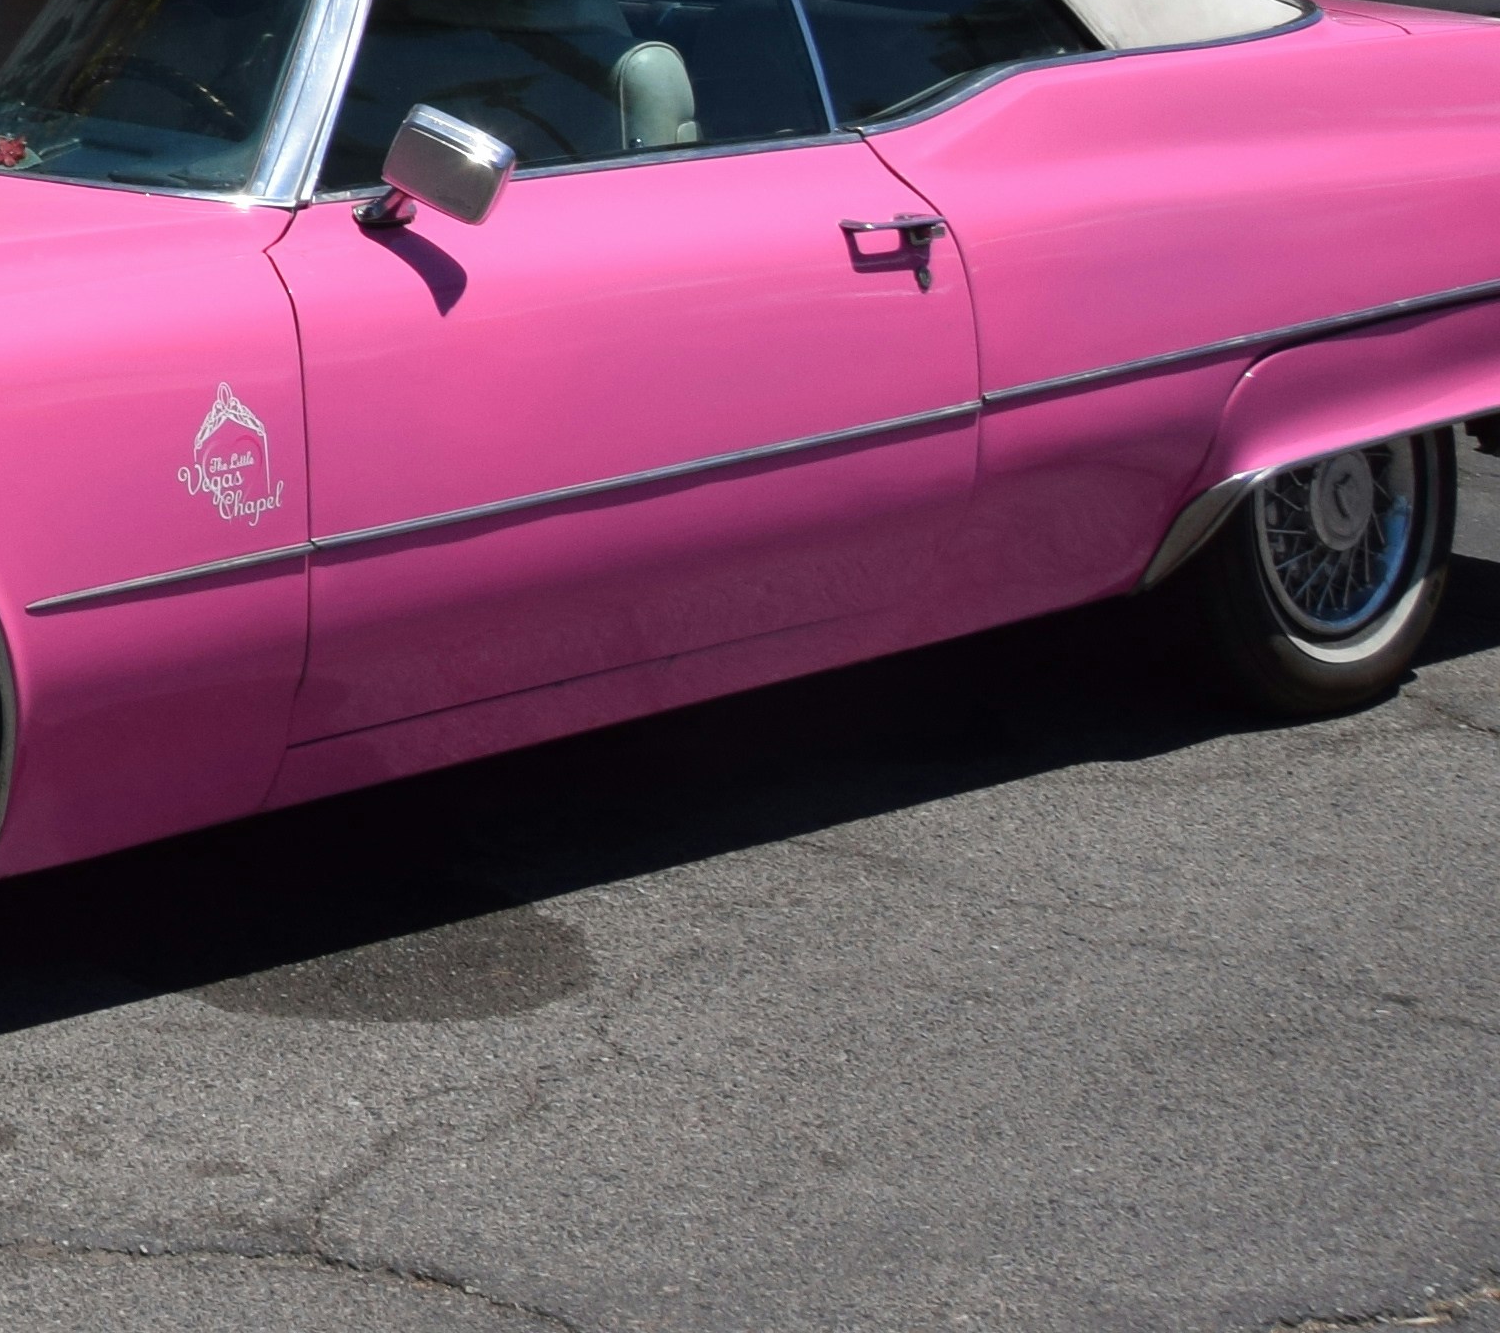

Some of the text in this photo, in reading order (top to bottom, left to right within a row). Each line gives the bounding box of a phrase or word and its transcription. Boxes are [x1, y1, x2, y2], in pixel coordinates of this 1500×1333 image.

[209, 451, 254, 473] The Little
[178, 464, 243, 505] Vegas
[219, 480, 284, 526] Chapel
